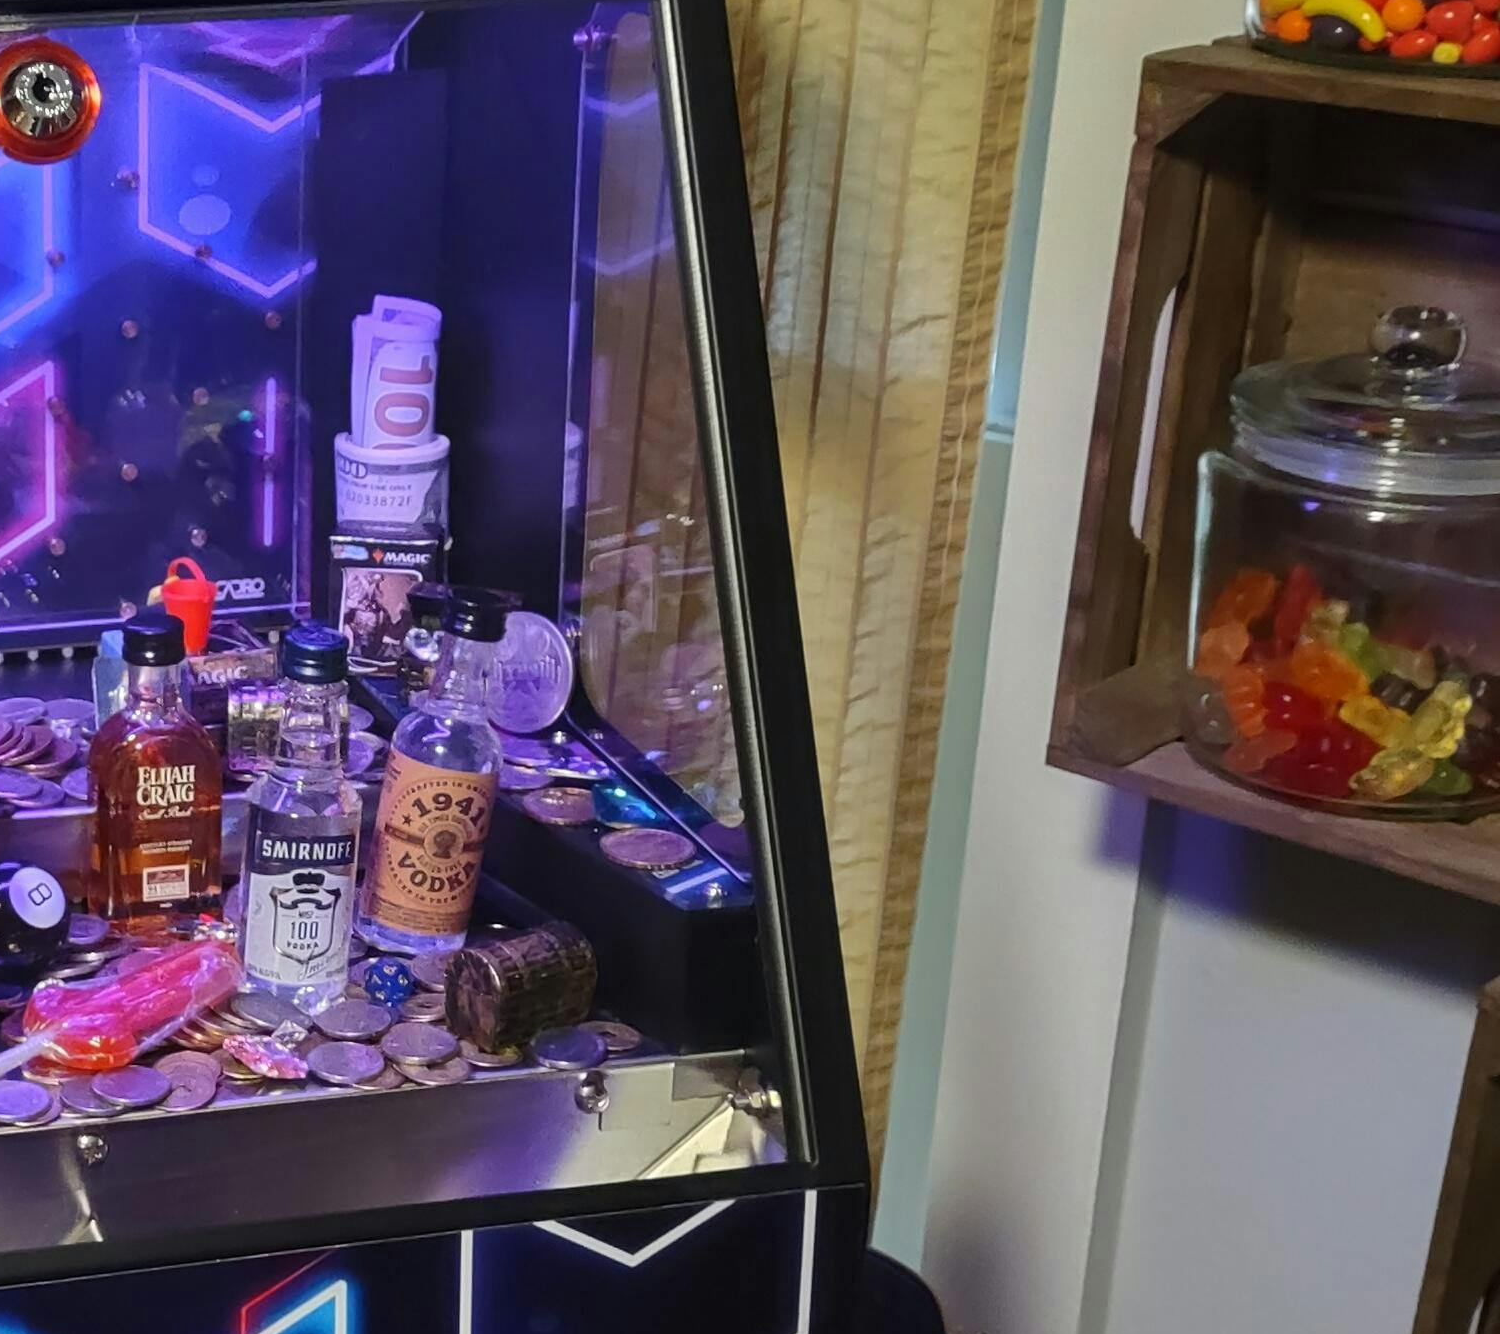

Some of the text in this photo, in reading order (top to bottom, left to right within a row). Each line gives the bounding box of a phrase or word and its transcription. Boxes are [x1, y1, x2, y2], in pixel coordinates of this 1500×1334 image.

[383, 551, 432, 565] MAGIC
[194, 665, 250, 686] AGIC
[137, 764, 197, 787] ELIJAH
[136, 783, 195, 807] CRAIG
[411, 791, 486, 828] 1941
[262, 839, 352, 862] SMIRNOFF
[398, 851, 477, 893] VODKA
[290, 920, 319, 940] 100
[286, 941, 320, 951] VODKA
